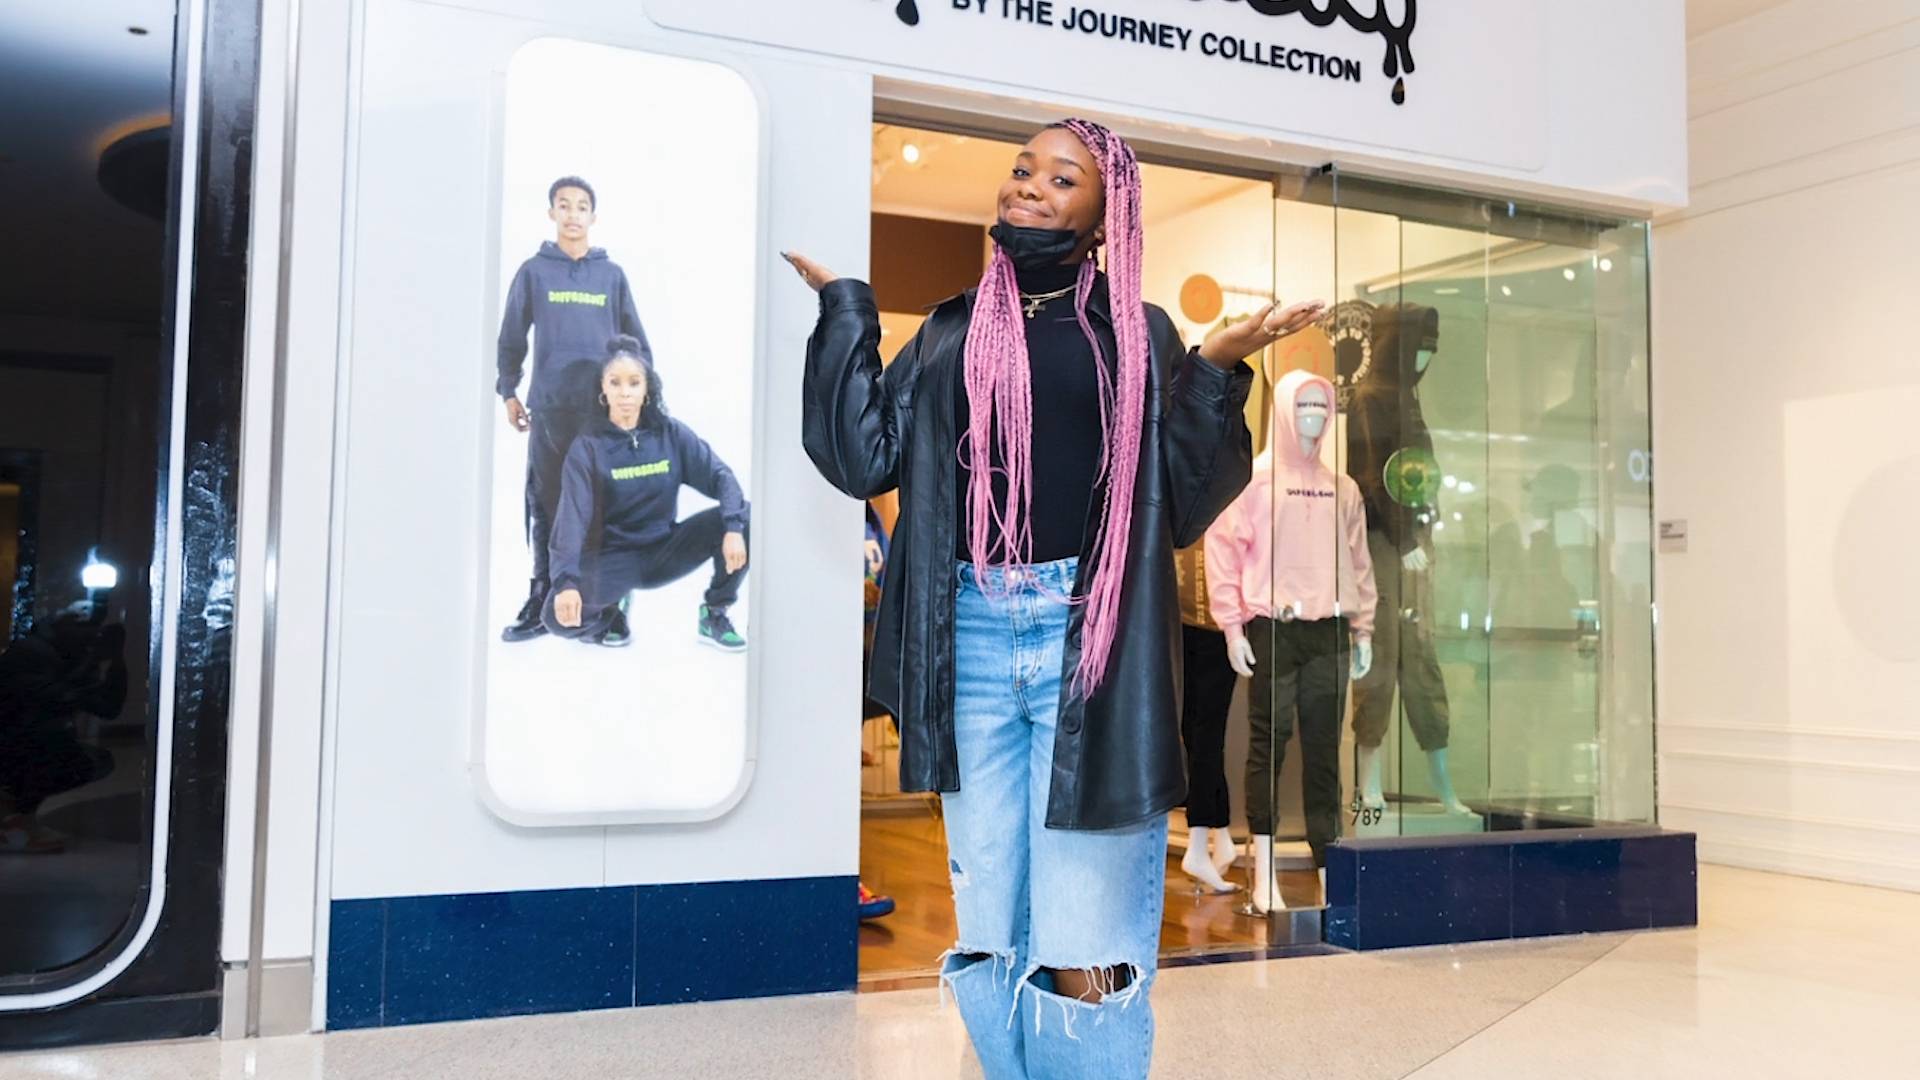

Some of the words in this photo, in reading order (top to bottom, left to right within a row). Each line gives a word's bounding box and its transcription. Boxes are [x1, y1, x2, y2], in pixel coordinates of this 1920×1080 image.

[1000, 0, 1054, 26] THE
[1061, 6, 1193, 51] JOURNEY
[1199, 32, 1361, 83] COLLECTION
[1351, 808, 1382, 826] 789
